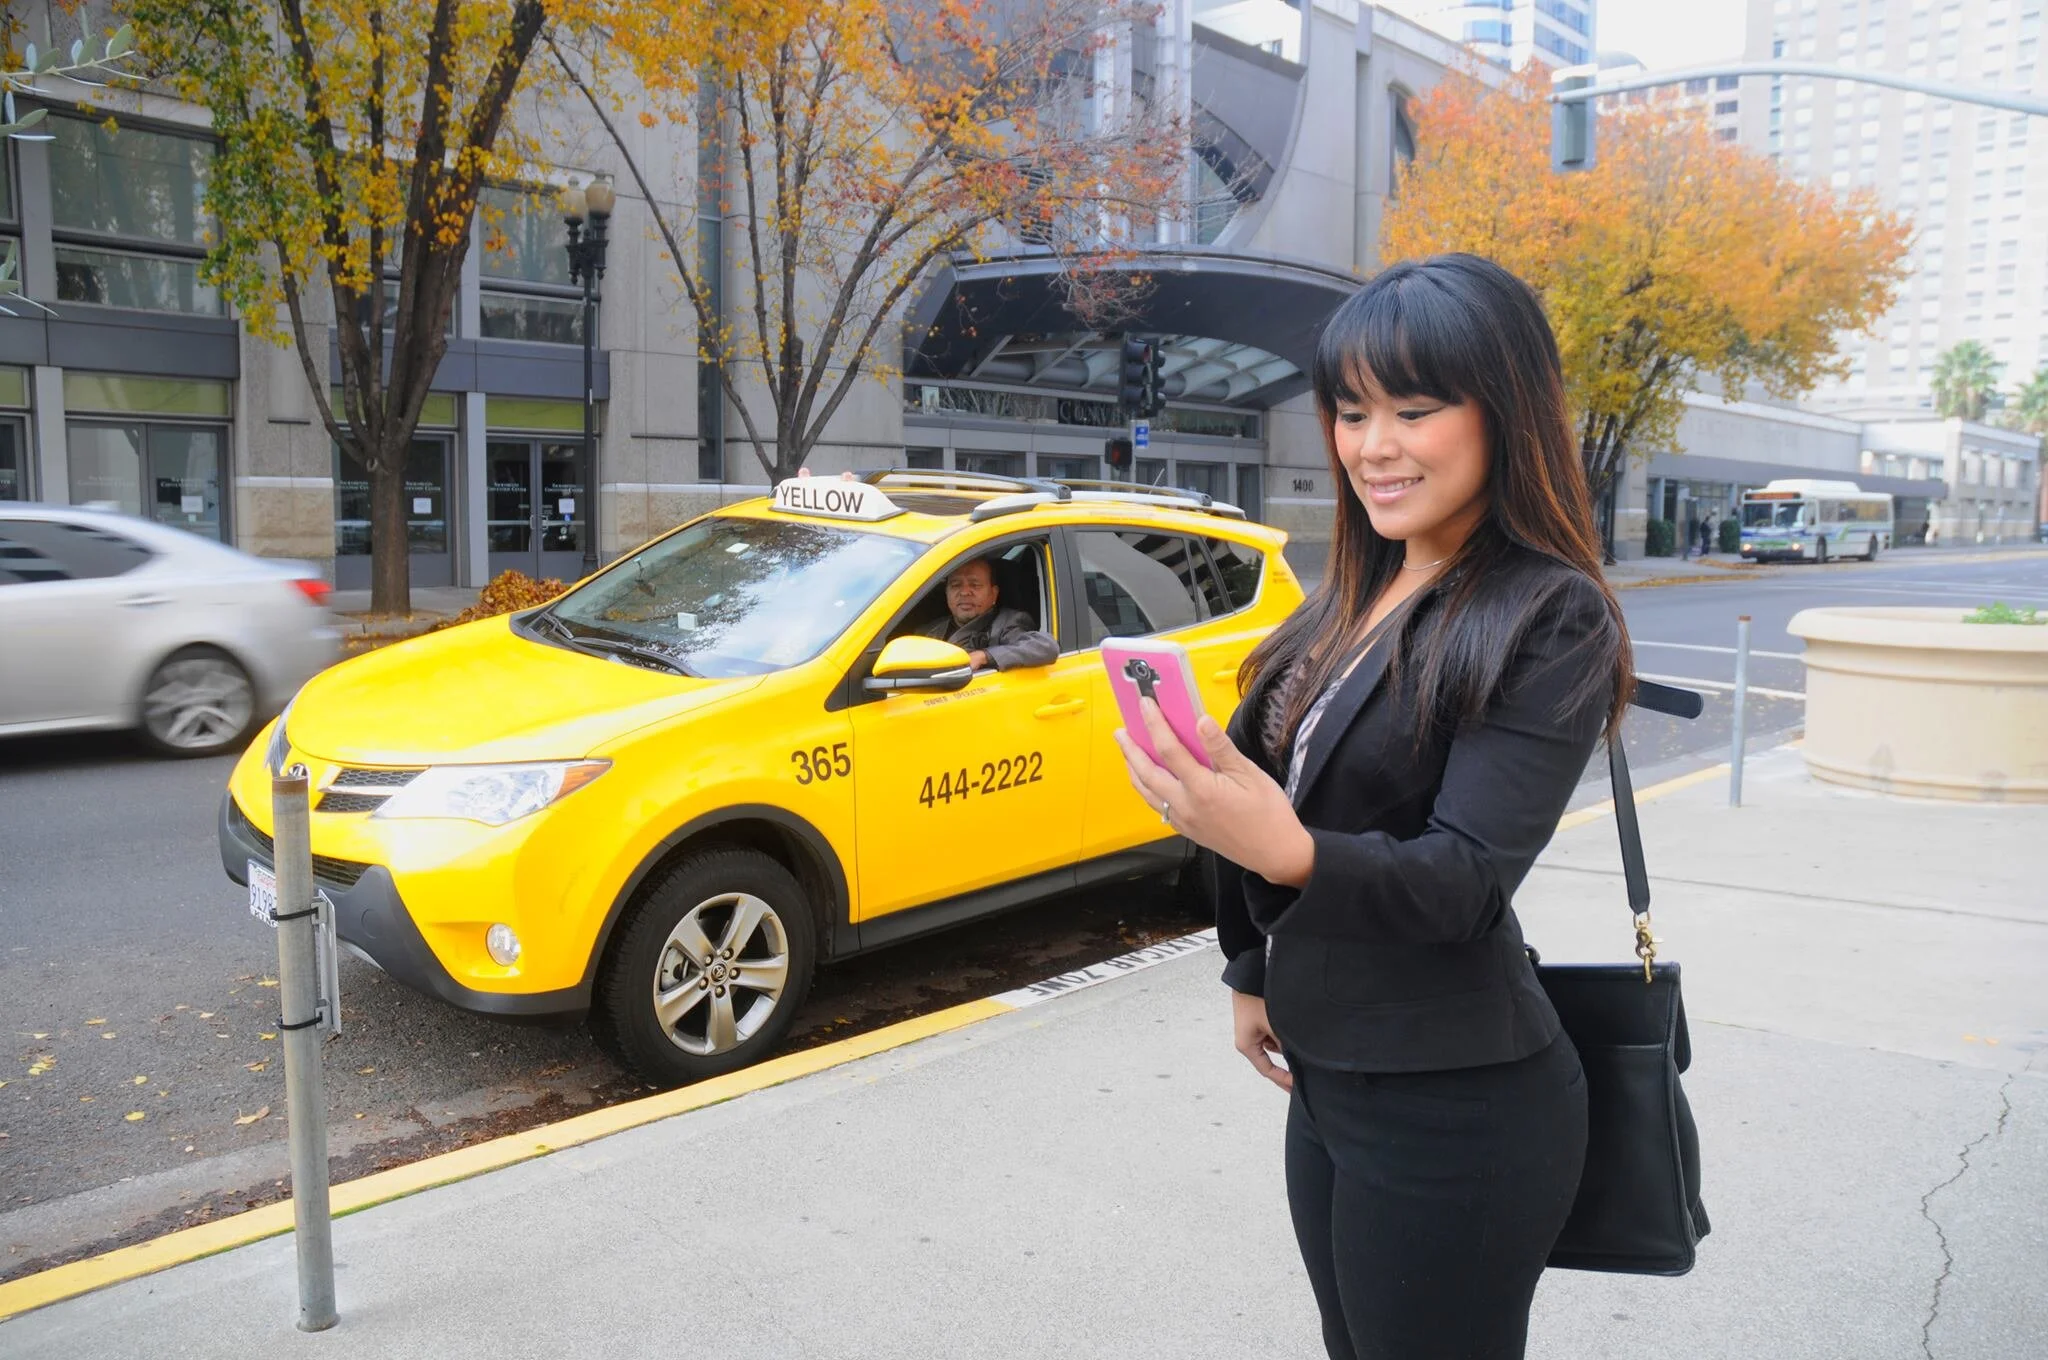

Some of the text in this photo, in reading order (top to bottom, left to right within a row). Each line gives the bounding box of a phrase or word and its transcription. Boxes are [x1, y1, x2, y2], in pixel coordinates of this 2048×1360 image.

[780, 485, 864, 514] YELLOW
[1292, 479, 1314, 492] 1400
[791, 742, 851, 786] 365
[919, 751, 1043, 809] 444-2222
[1027, 933, 1218, 997] TAXICAB ZONE
